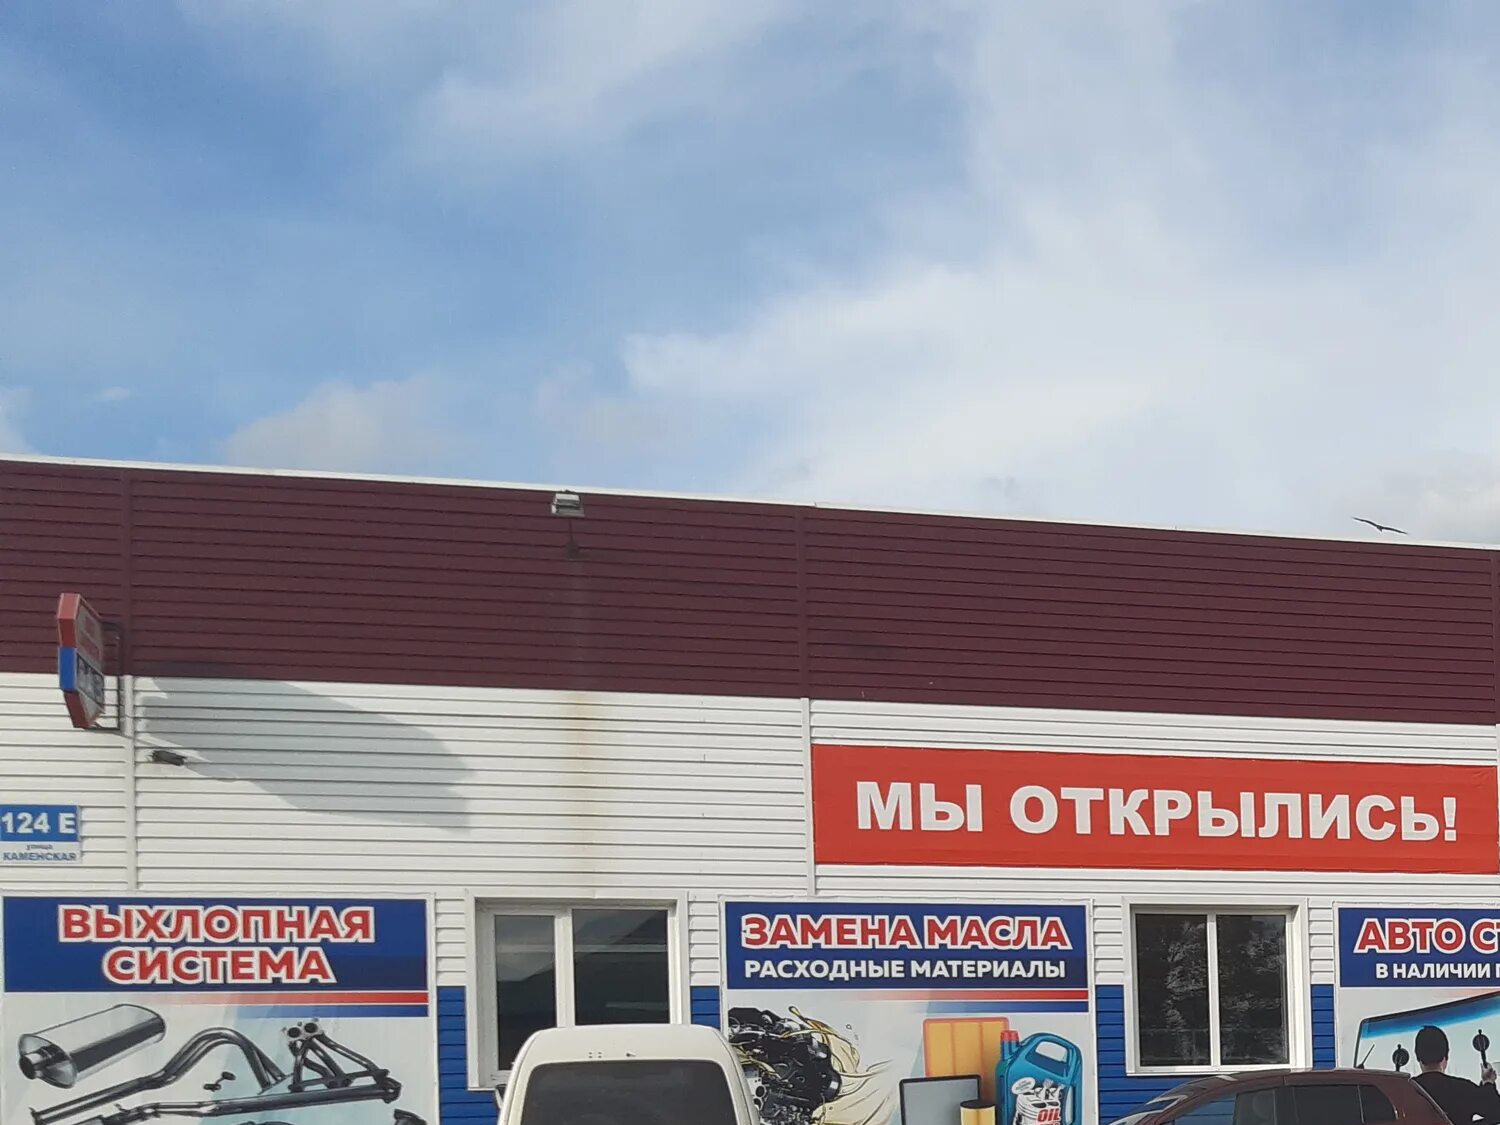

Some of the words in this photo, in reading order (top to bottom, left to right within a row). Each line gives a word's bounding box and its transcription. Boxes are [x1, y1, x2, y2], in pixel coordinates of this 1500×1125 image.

[1, 811, 51, 834] 124
[58, 812, 76, 834] Е
[855, 780, 984, 832] МЫ
[1009, 785, 1458, 841] ОТКРЫЛИСЬ!
[2, 852, 77, 861] КАМЕНСКАЯ
[59, 905, 375, 943] ВЫХЛОПНАЯ
[742, 914, 921, 949] ЗАМЕНА
[925, 915, 1072, 950] МАСЛА
[1354, 918, 1466, 954] АВТО
[104, 947, 336, 985] СИСТЕМА
[745, 960, 905, 981] РАСХОДНЫЕ
[910, 960, 1065, 978] МАТЕРИАЛЫ
[1375, 963, 1389, 979] В
[1393, 963, 1491, 979] НАЛИЧИИ
[1037, 1108, 1060, 1122] OIL
